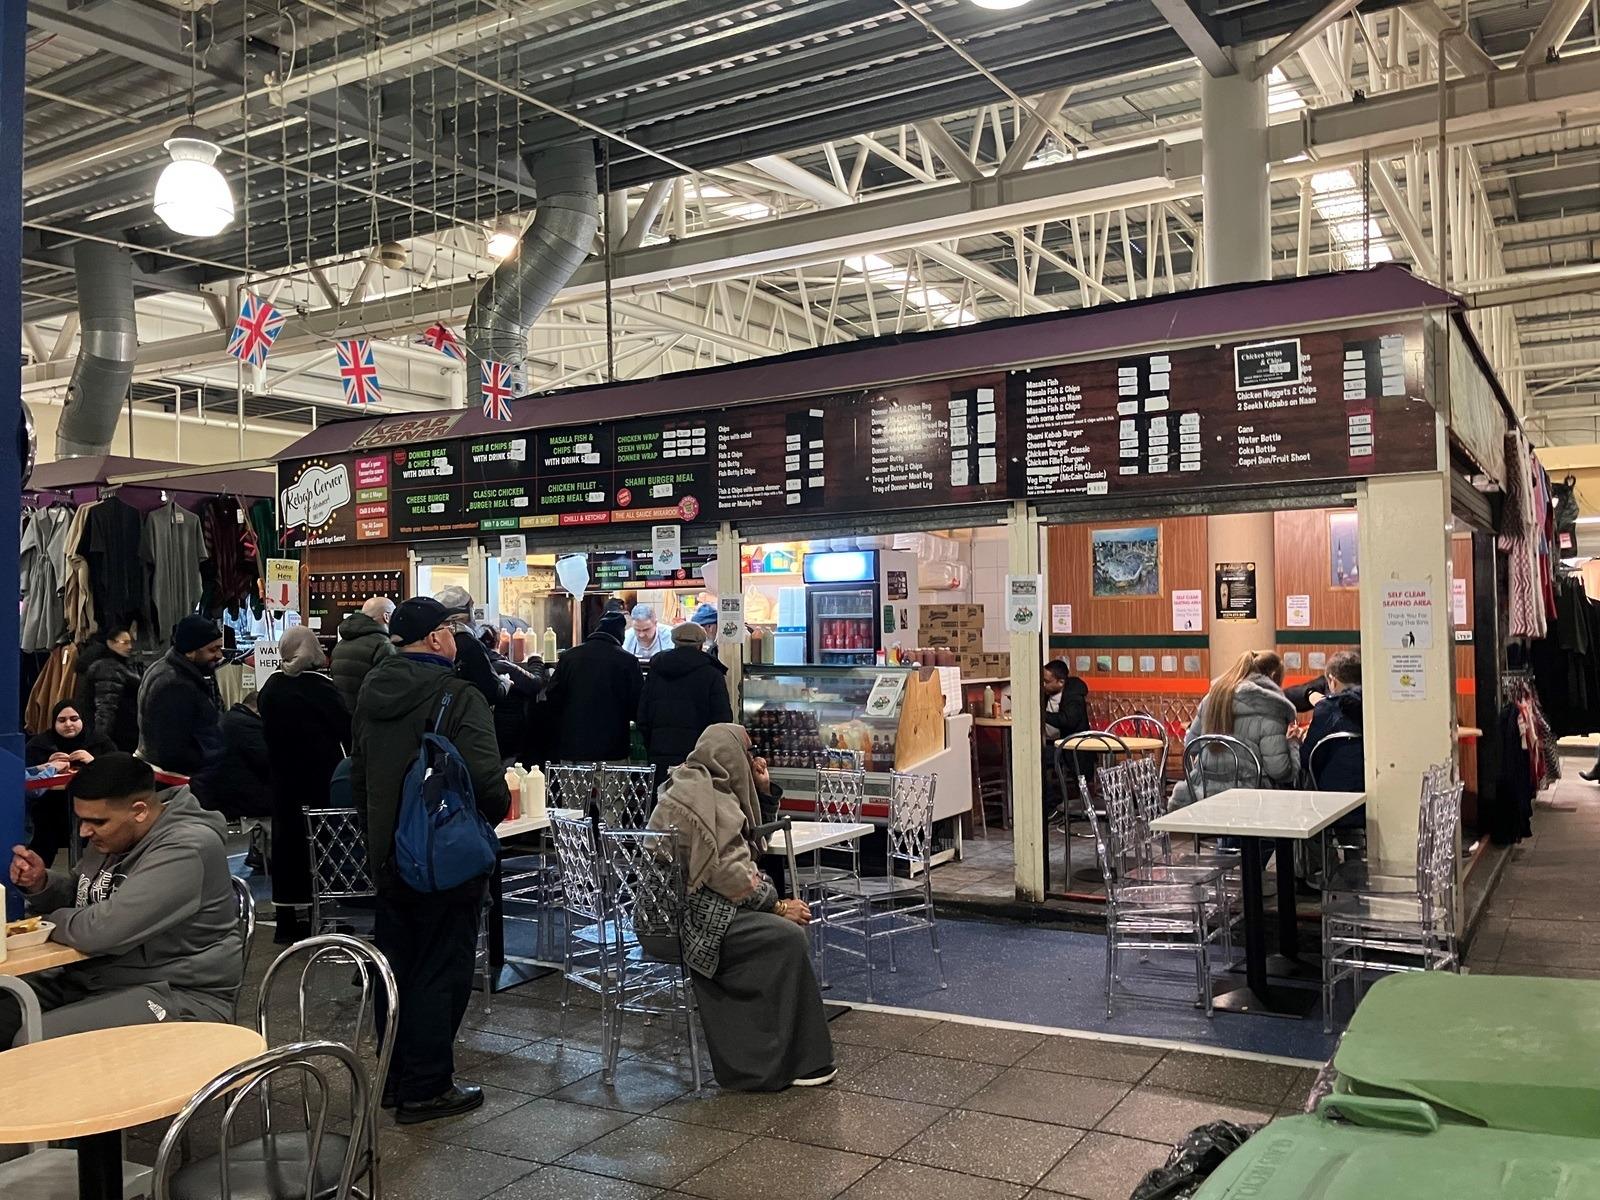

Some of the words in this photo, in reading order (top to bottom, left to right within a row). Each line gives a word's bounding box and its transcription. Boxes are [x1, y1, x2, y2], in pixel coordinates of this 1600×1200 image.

[1241, 353, 1264, 361] Chicken
[1047, 387, 1058, 395] Fish
[1065, 385, 1080, 393] Chips
[1237, 392, 1262, 400] Chicken
[1263, 388, 1290, 398] Nuggets
[1299, 385, 1316, 395] Chips
[1065, 403, 1080, 411] Chips
[1264, 400, 1288, 408] Kebabs
[372, 416, 451, 435] KEBAB
[352, 426, 449, 448] CORNER
[618, 435, 641, 443] CHICKEN
[643, 433, 659, 441] WRAP
[1063, 430, 1083, 438] Burger
[1238, 436, 1259, 444] Water
[1261, 433, 1281, 442] Bottle
[550, 435, 573, 444] MASALA
[1047, 440, 1067, 448] Burger
[472, 444, 483, 452] FISH
[491, 442, 507, 451] CHIPS
[553, 446, 570, 455] CHIPS
[1049, 448, 1069, 456] Burger
[1070, 445, 1090, 453] Classic
[1239, 447, 1254, 455] Coke
[1256, 445, 1276, 453] Bottle
[409, 451, 430, 459] DONNER
[432, 449, 446, 457] MEAT
[473, 454, 487, 462] WITH
[489, 452, 505, 461] DRINK
[618, 454, 640, 462] DONNER
[414, 460, 429, 468] CHIPS
[545, 457, 560, 466] WITH
[561, 456, 579, 465] DRINK
[1239, 457, 1257, 467] Capri
[1291, 452, 1310, 462] Shoot
[403, 469, 417, 478] WITH
[418, 468, 435, 477] DRINK
[625, 477, 645, 486] SHAMI
[648, 475, 674, 484] BURGER
[676, 473, 694, 482] MEAL
[1039, 475, 1059, 484] Burger
[548, 484, 575, 492] CHICKEN
[577, 481, 596, 490] FILLET
[287, 488, 312, 509] Kebab
[314, 475, 342, 496] Corner
[473, 490, 497, 499] CLASSIC
[498, 488, 524, 496] CHICKEN
[406, 495, 426, 504] CHEESE
[428, 494, 449, 502] BURGER
[494, 499, 509, 507] MEAL
[541, 495, 565, 504] BURGER
[567, 494, 583, 503] MEAL
[412, 505, 426, 513] MEAL
